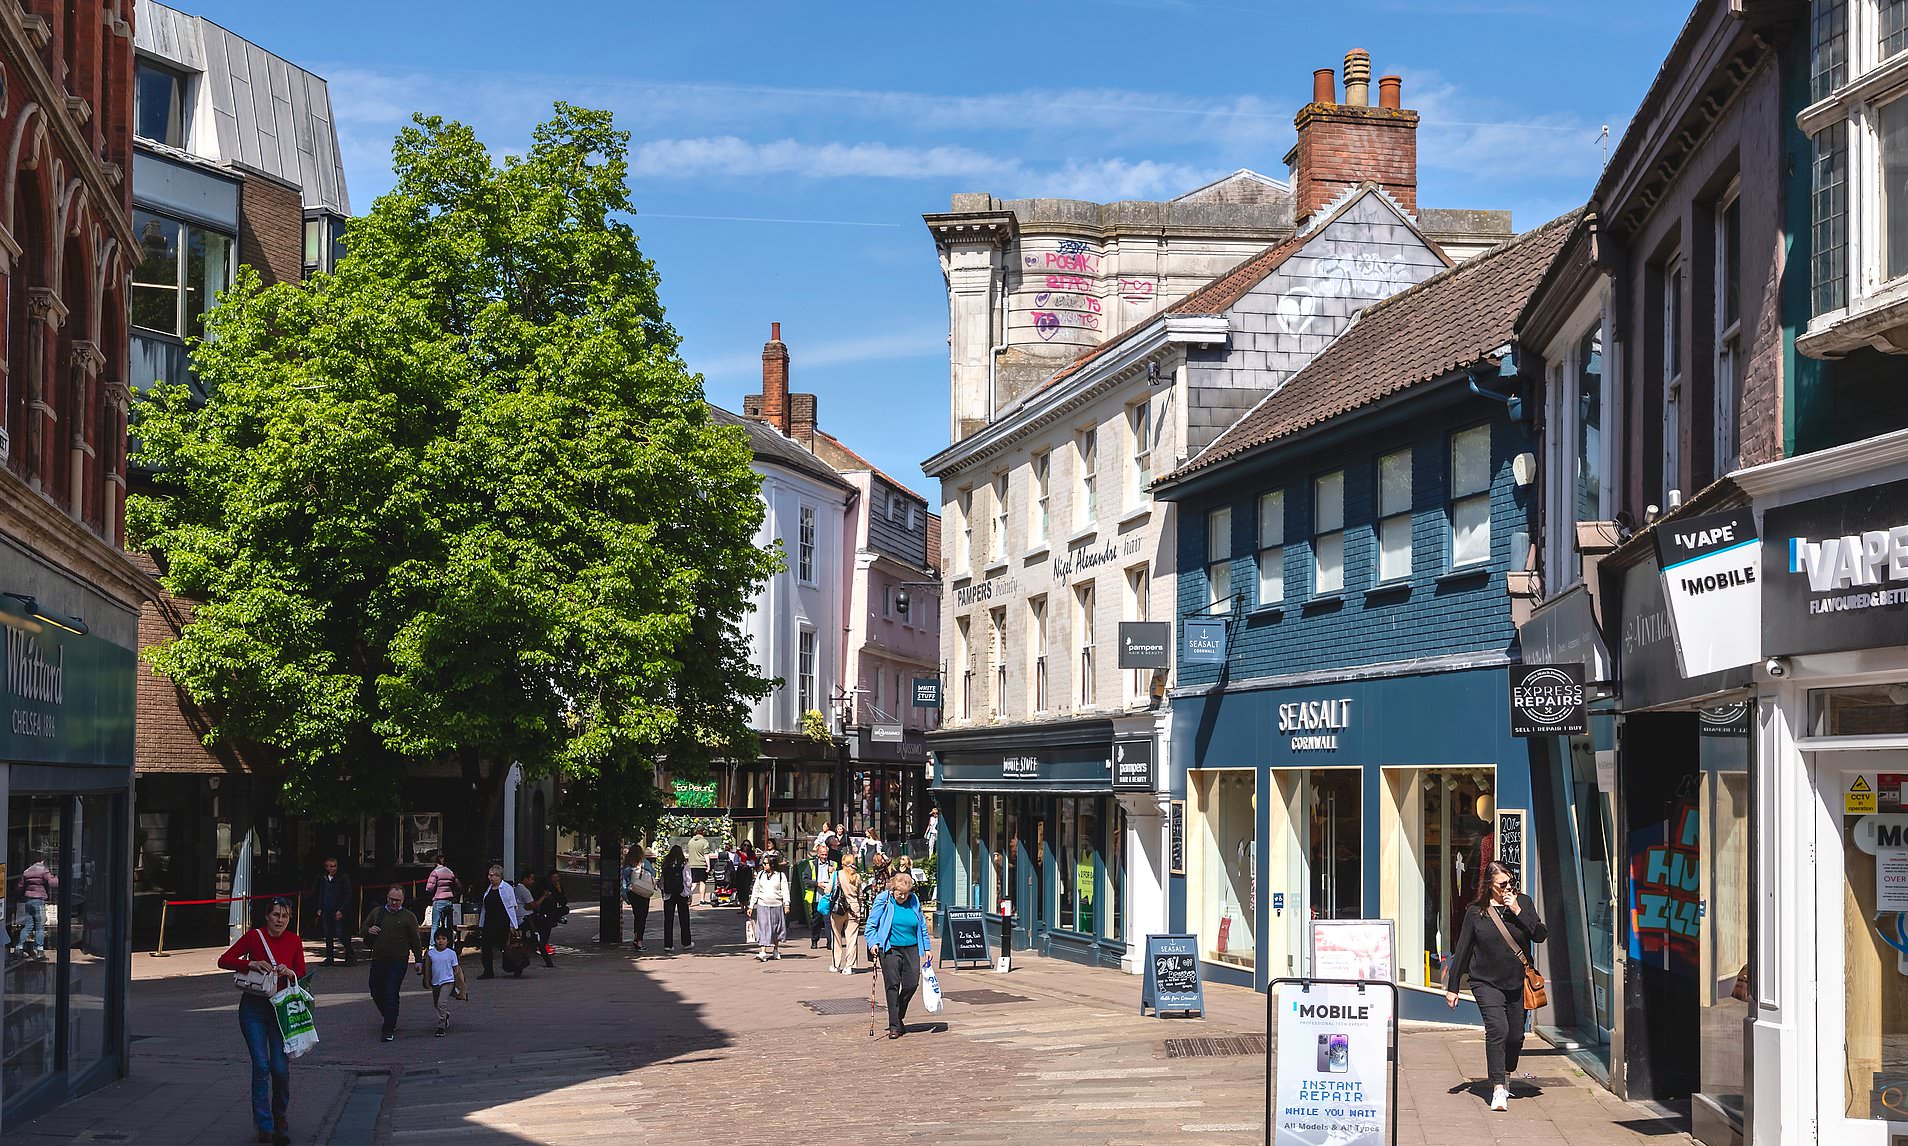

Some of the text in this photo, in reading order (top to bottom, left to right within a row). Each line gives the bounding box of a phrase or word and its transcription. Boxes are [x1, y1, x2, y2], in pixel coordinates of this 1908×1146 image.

[1053, 535, 1144, 587] Nigel Alexandre hair
[957, 575, 1018, 607] PAMPERS beauty
[6, 624, 64, 705] Whittard
[1514, 685, 1582, 697] EXPRESS
[1514, 695, 1582, 707] REPAIRS
[1279, 699, 1353, 731] SEASALT
[12, 709, 41, 737] CHELSEA
[1292, 736, 1338, 750] CORNWALL
[1003, 757, 1037, 771] WHITE STUFF
[1120, 763, 1147, 775] pampers
[1157, 956, 1180, 975] 20%
[1302, 1080, 1362, 1090] INSTANT
[1300, 1091, 1363, 1102] REPAIR
[1285, 1107, 1319, 1115] WHILE
[1355, 1125, 1380, 1133] Types
